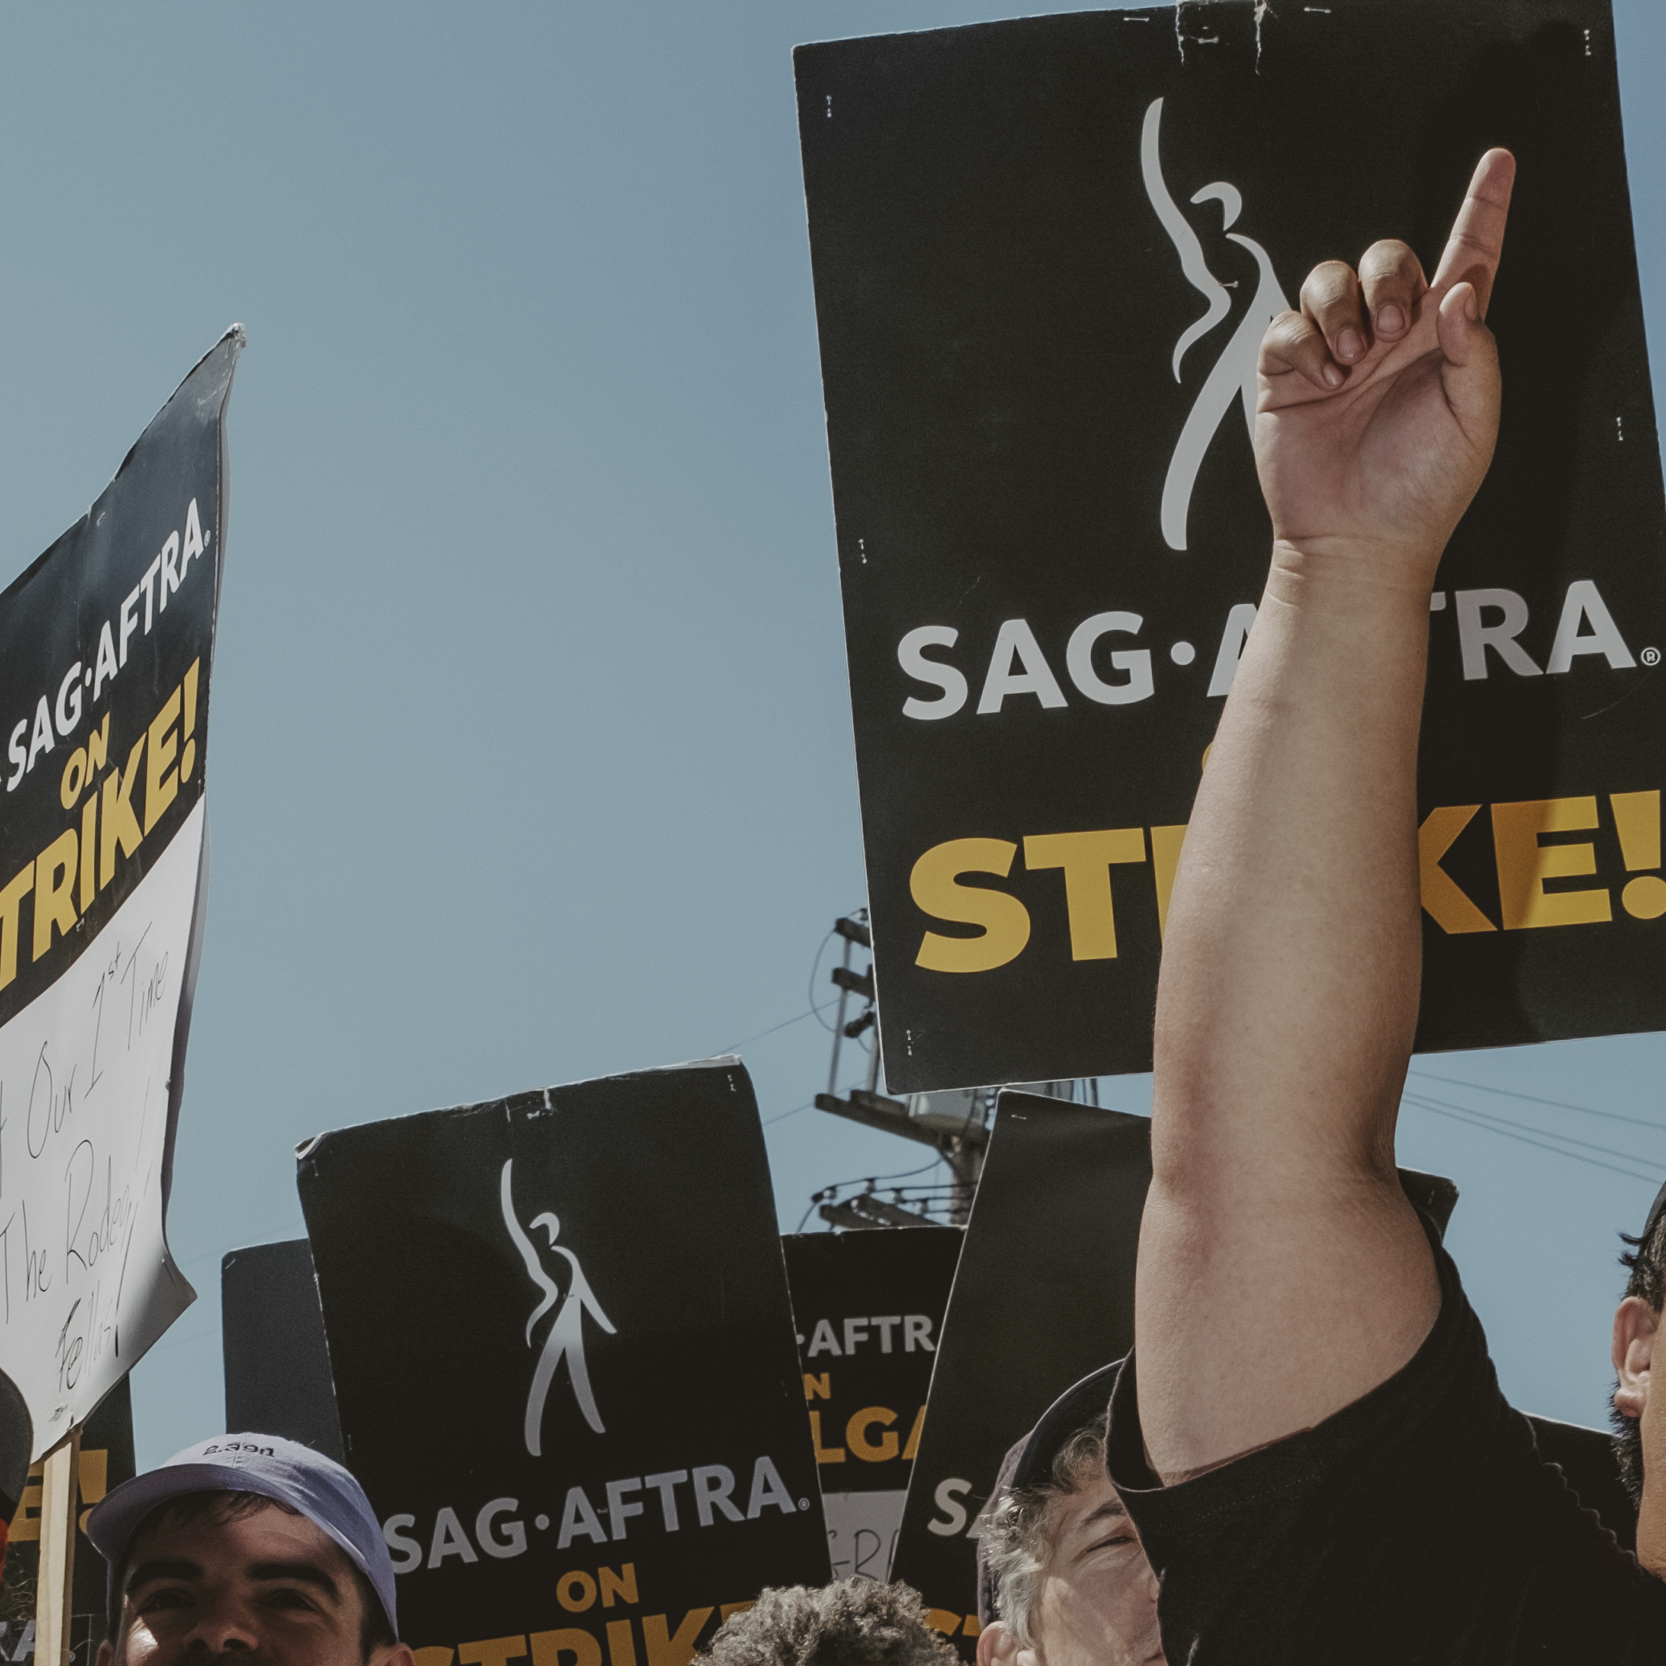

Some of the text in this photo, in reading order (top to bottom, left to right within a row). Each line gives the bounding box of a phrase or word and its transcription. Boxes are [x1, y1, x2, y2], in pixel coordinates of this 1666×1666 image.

[61, 712, 110, 810] ON
[27, 1041, 77, 1159] Our
[120, 921, 169, 1051] Time
[556, 1562, 640, 1613] ON
